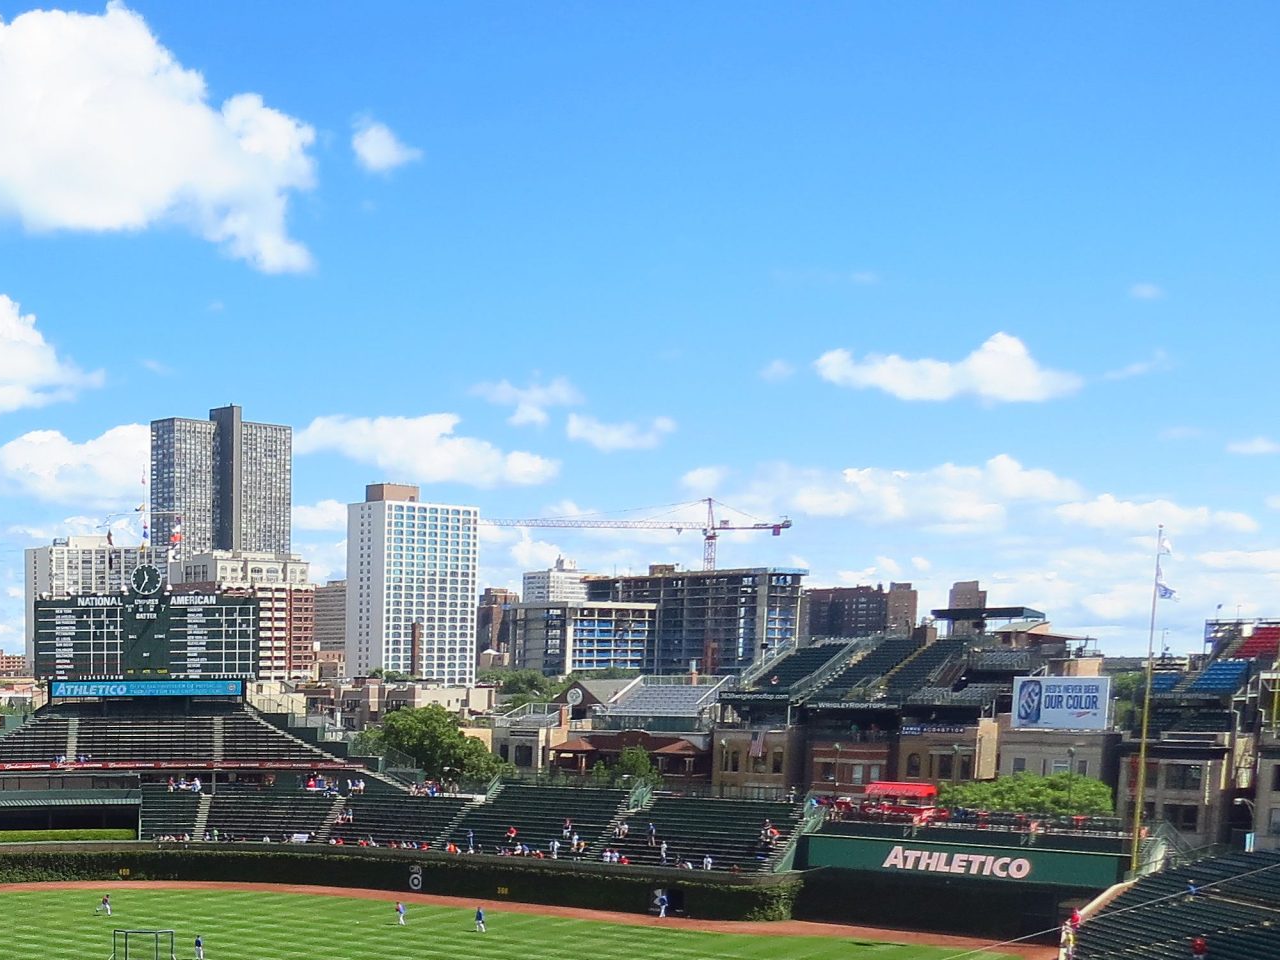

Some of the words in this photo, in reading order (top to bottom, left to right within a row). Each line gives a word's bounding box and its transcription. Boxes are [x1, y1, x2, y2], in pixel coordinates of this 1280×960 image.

[77, 597, 123, 606] NATIONAL
[170, 595, 216, 605] AMERICAN
[54, 683, 127, 695] ATHLETICO
[1063, 685, 1082, 694] NEVER
[1044, 695, 1064, 709] OUR
[882, 845, 1031, 879] ATHLETICO
